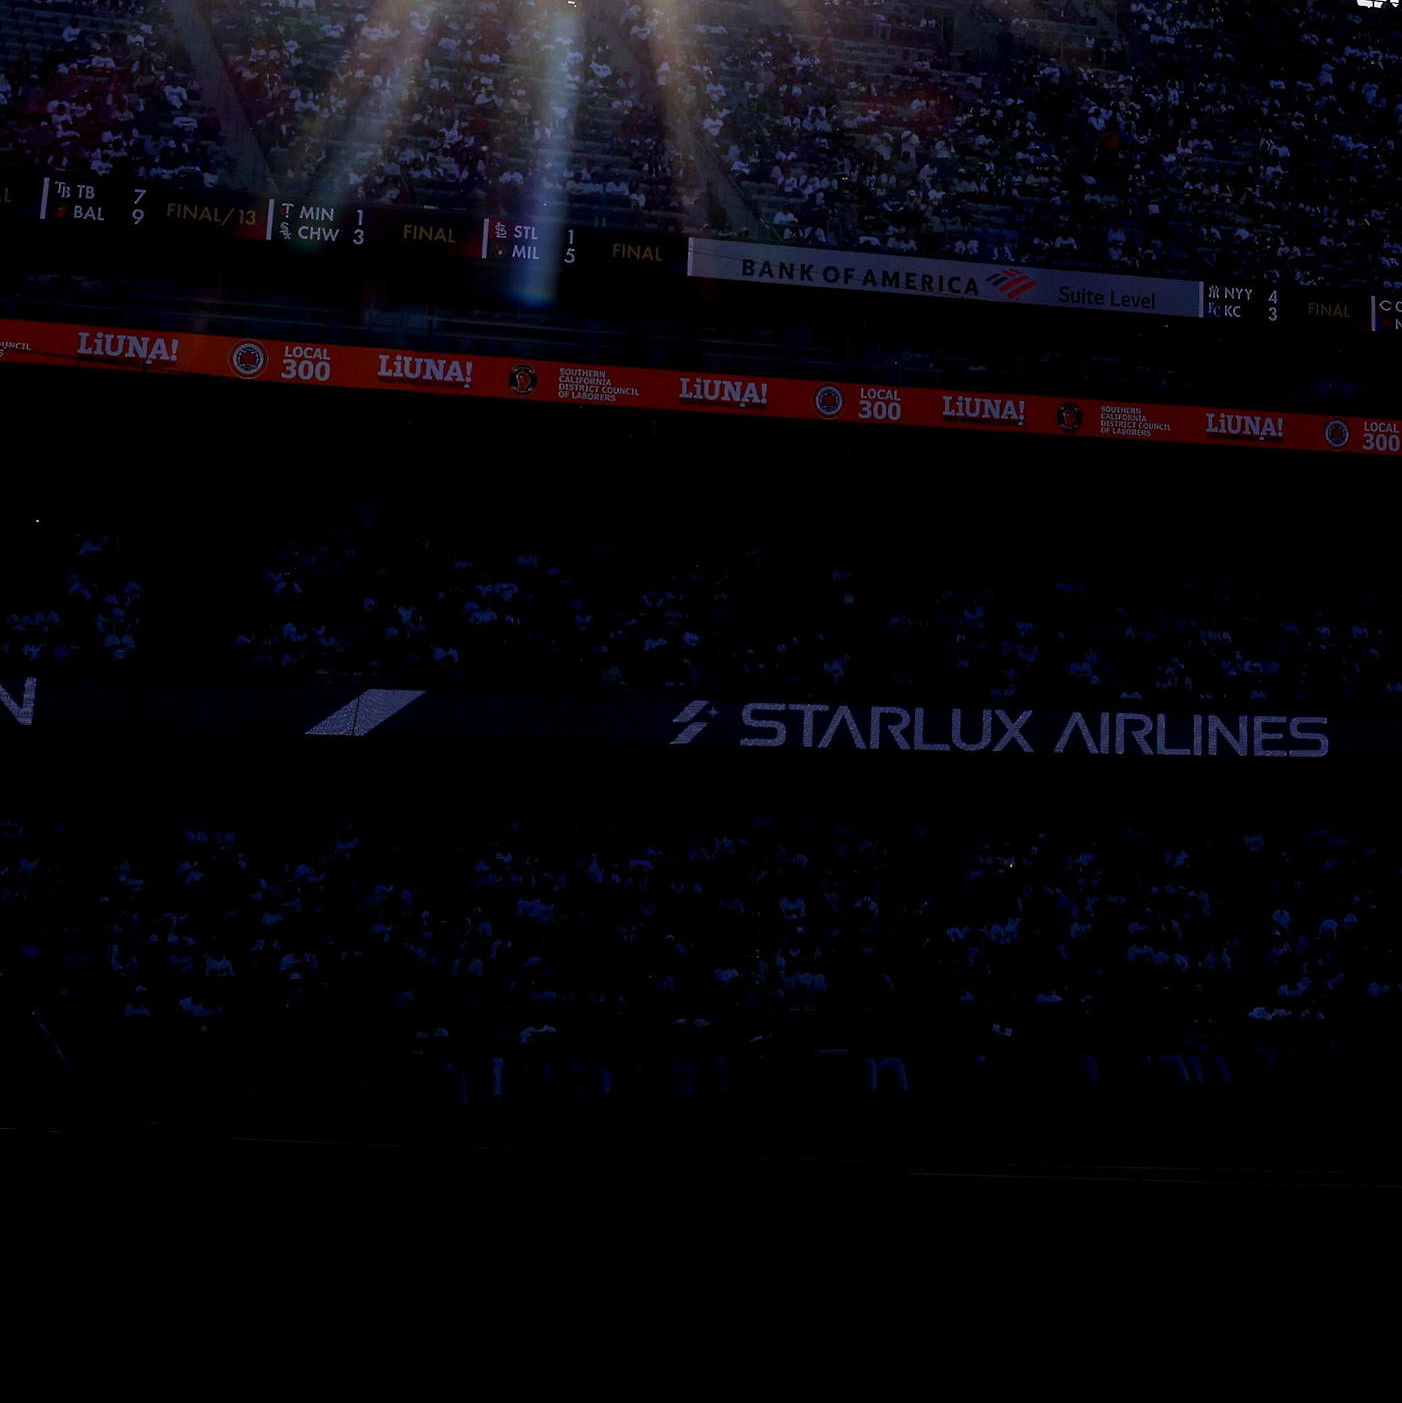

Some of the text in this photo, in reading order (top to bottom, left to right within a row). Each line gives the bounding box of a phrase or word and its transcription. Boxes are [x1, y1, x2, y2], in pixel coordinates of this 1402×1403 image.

[77, 184, 147, 204] TB 7
[73, 204, 145, 226] BAL 9
[166, 201, 257, 227] FINAL/13
[299, 206, 365, 226] MIN 1
[297, 226, 366, 246] CHW 3
[402, 223, 456, 244] FINAL
[513, 225, 575, 246] STL 1
[512, 244, 576, 265] MIL 5
[611, 243, 663, 262] FINAL
[742, 258, 979, 297] BANK OF AMERICA
[1058, 286, 1155, 310] Suite Level
[1224, 288, 1278, 304] NYY 4
[1224, 305, 1278, 322] KC 3
[1307, 302, 1351, 318] FINAL
[76, 331, 180, 365] LiUNA!
[284, 345, 331, 361] LOCAL
[280, 359, 331, 382] 300
[377, 354, 473, 388] LiUNA!
[559, 367, 606, 379] SOUTHERN
[558, 375, 612, 387] CALIFORNIA
[558, 382, 640, 397] DISTRICT COUNCIL
[558, 390, 617, 402] OF LABORERS
[679, 376, 769, 407] LiUNA!
[860, 388, 901, 402] LOCAL
[858, 400, 902, 421] 300
[942, 395, 1026, 426] LiUNA!
[1100, 405, 1142, 415] SOUTHERN
[1100, 412, 1147, 423] CALIFORNIA
[1100, 420, 1172, 432] DISTRICT COUNCIL
[1101, 427, 1152, 438] OF LABORERS
[1205, 412, 1285, 442] LiUNA!
[1363, 421, 1400, 434] LOCAL
[1362, 434, 1401, 452] 300
[740, 702, 1330, 758] STARLUX AIRLINES
